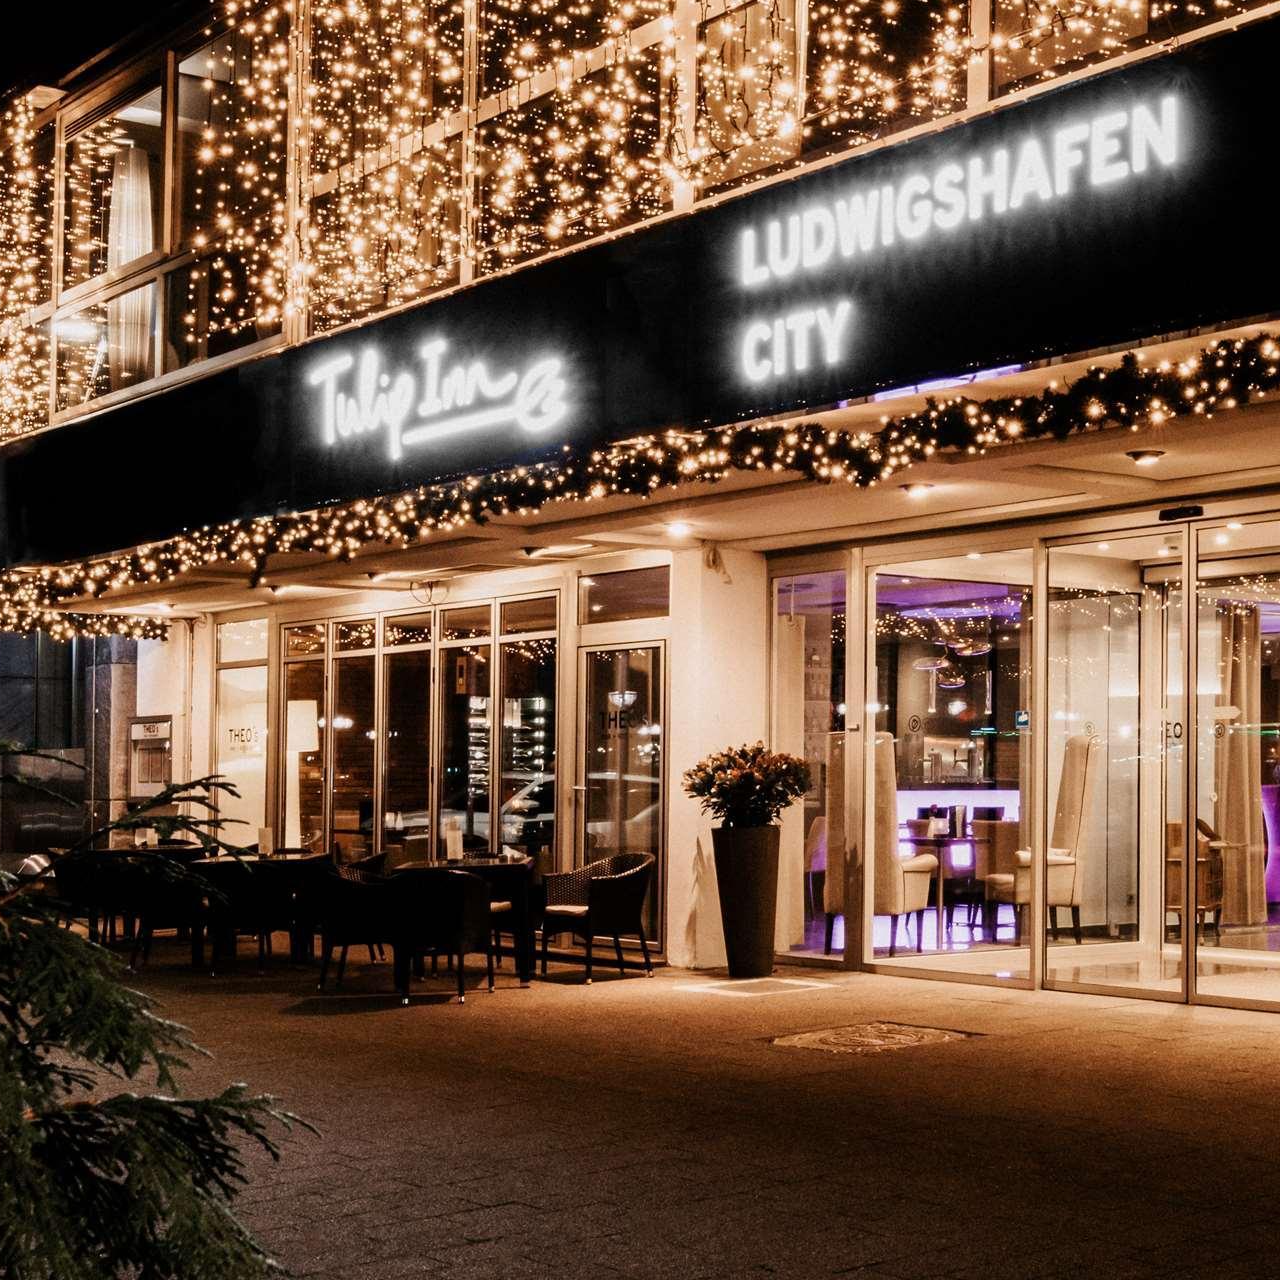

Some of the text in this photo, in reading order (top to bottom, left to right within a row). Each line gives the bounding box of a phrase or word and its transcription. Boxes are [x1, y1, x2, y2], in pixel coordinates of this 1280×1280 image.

[740, 94, 1179, 287] LUDWIGSHAFEN
[308, 338, 519, 461] Tulip Inn
[741, 300, 853, 383] CITY
